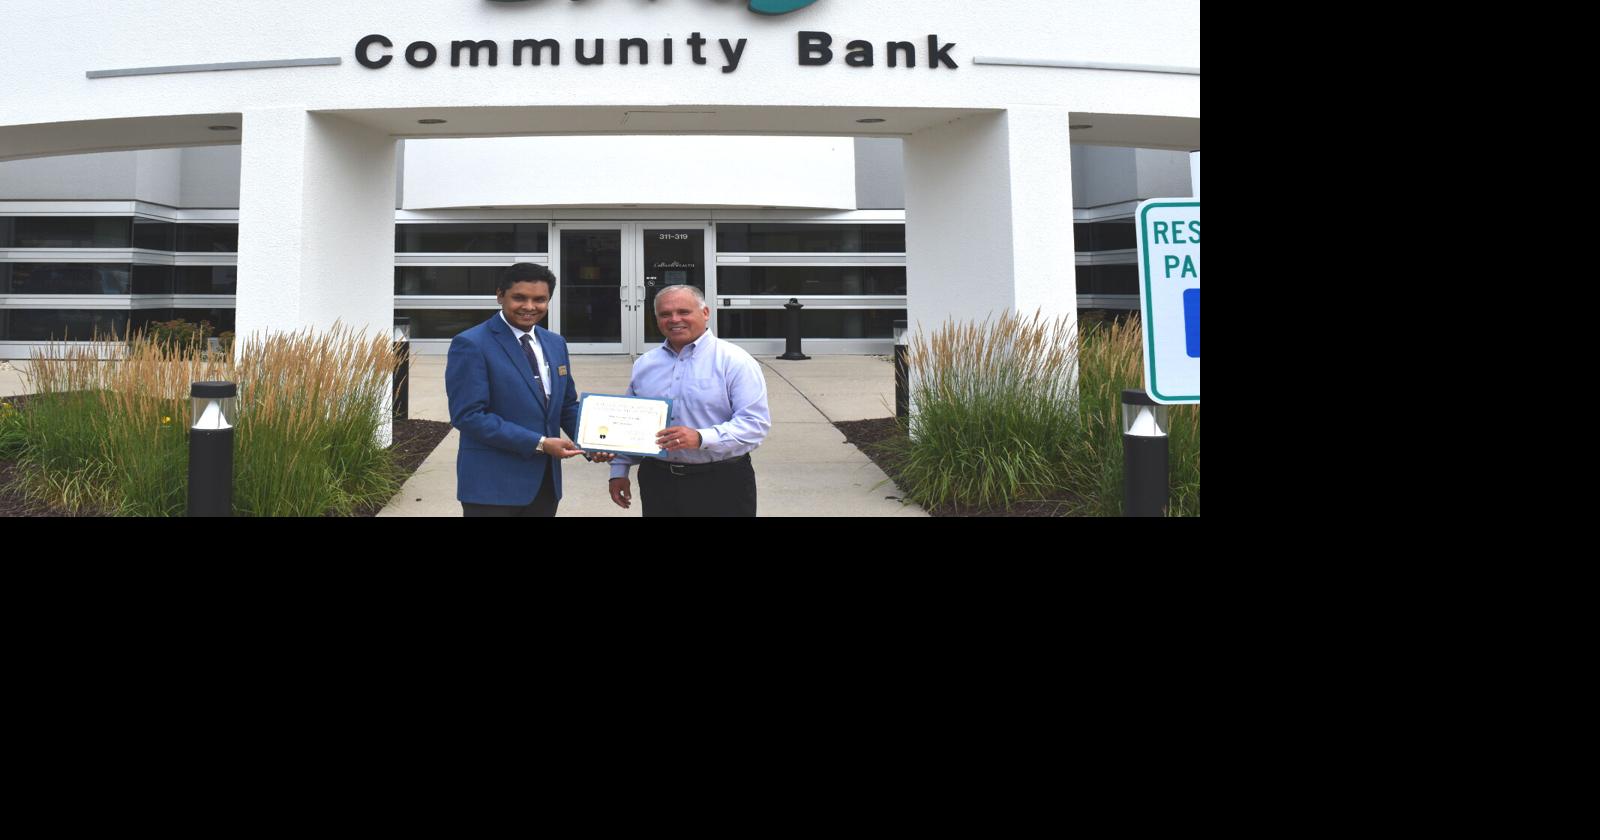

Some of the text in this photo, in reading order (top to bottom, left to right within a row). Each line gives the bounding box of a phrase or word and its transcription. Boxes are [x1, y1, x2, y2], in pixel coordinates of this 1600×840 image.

[354, 30, 959, 74] Community Bank
[1153, 220, 1200, 245] RES
[1164, 254, 1198, 279] PA
